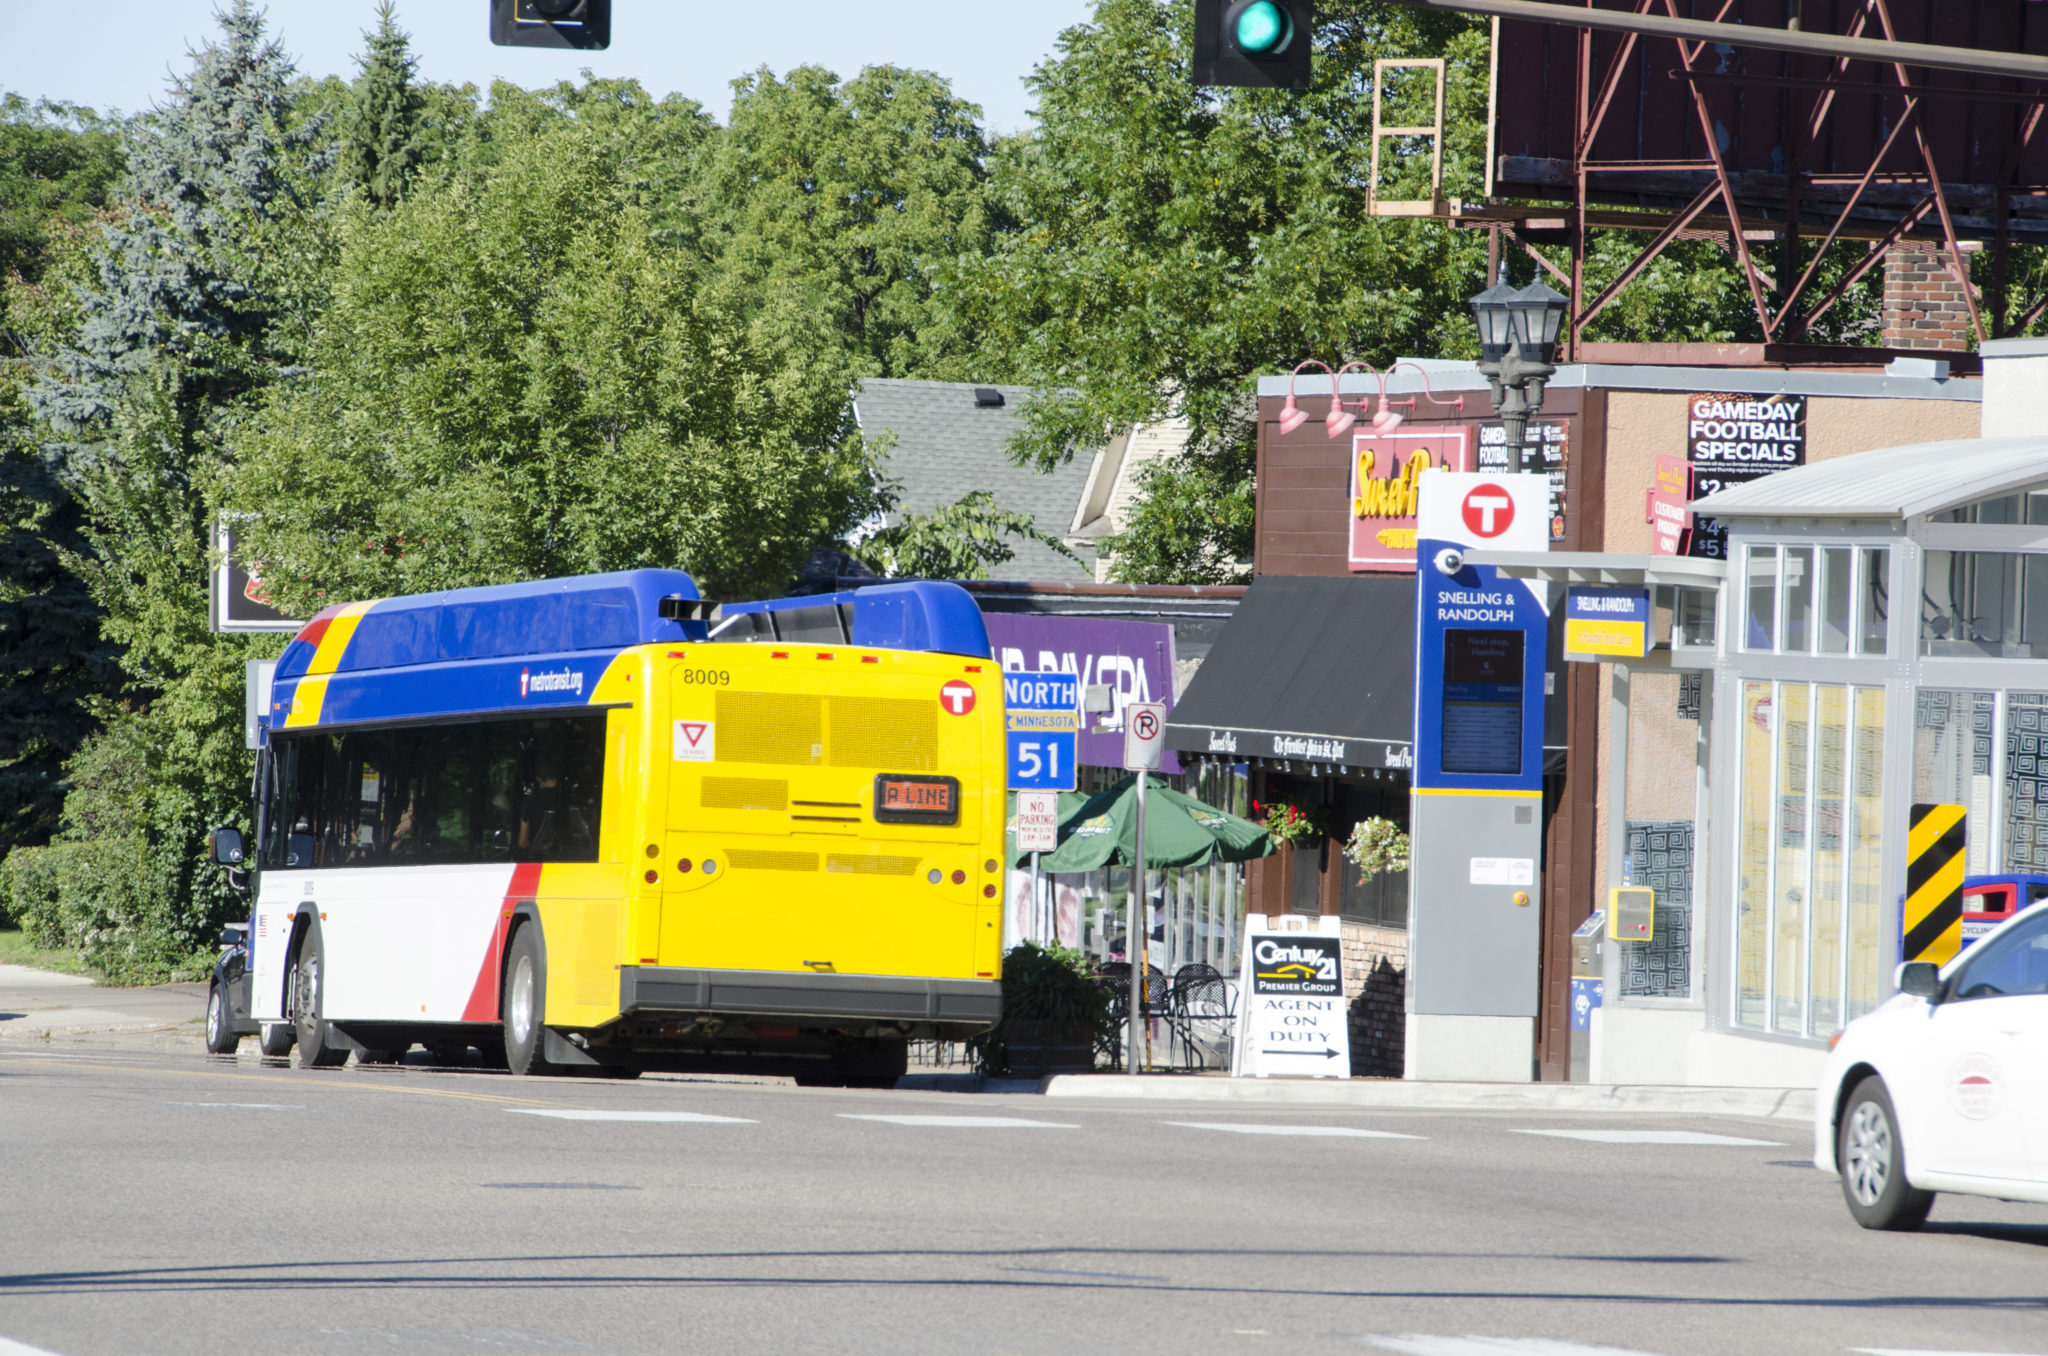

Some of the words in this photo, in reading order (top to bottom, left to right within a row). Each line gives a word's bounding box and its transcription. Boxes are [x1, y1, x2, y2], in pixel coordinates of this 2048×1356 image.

[1693, 401, 1801, 421] GAMEDAY
[1690, 421, 1802, 441] FOOTBALL
[1695, 442, 1797, 462] SPECIALS
[1354, 450, 1410, 517] Sweet
[1700, 479, 1721, 496] $2
[1468, 495, 1508, 533] T
[1655, 501, 1685, 522] CUSTOMER
[1657, 518, 1681, 537] PARKING
[1700, 519, 1720, 537] $4
[1661, 537, 1675, 553] ONLY
[1699, 539, 1719, 557] $5
[1438, 591, 1502, 605] SNELLING
[1505, 594, 1515, 606] &
[1438, 608, 1514, 623] RANDOLPH
[529, 666, 584, 696] metrotransit.org
[683, 669, 731, 686] 8009
[943, 687, 972, 714] T
[1005, 678, 1076, 706] NORTH
[1016, 714, 1075, 729] MINNESOTA
[1017, 742, 1058, 778] 51
[888, 786, 898, 804] A
[905, 788, 948, 806] LINE
[1030, 801, 1045, 813] NO
[1020, 814, 1054, 826] PARKING
[1962, 926, 1994, 935] CYCLIN
[1255, 940, 1324, 966] Century
[1316, 957, 1337, 980] 21
[1259, 980, 1301, 991] PREMIER
[1302, 982, 1337, 993] GROUP
[1264, 999, 1335, 1011] AGENT
[1283, 1015, 1317, 1026] ON
[1270, 1031, 1331, 1043] DUTY
